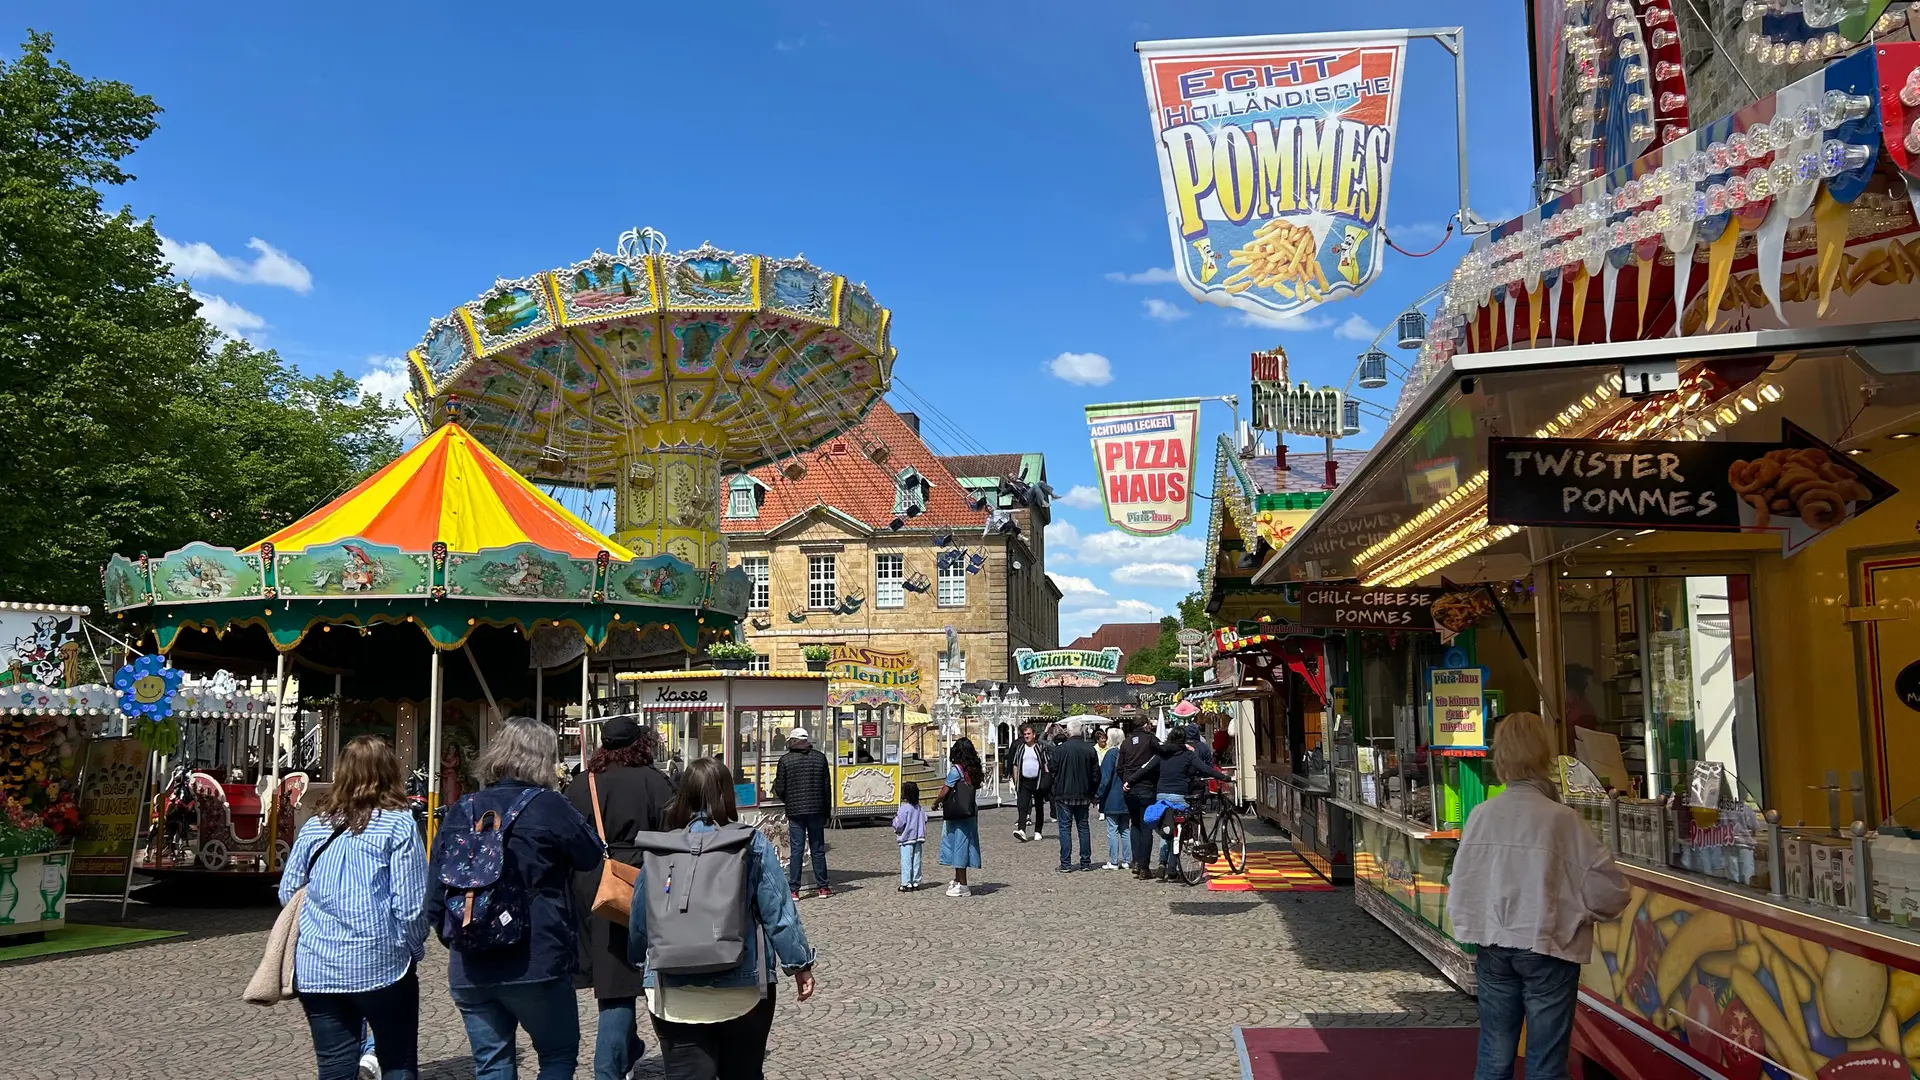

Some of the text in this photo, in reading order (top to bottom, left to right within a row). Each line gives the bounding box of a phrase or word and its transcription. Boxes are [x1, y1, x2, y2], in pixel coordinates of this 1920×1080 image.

[1179, 55, 1339, 99] ECHT
[1165, 76, 1391, 126] HOLLÄNDISCHE
[1161, 115, 1391, 241] POMMES
[1251, 351, 1280, 381] Pizza
[1091, 423, 1133, 437] ACHTUNG
[1134, 416, 1172, 431] LECKER!
[1104, 438, 1187, 471] PIZZA
[1109, 472, 1185, 504] HAUS
[1562, 486, 1718, 517] POMMES
[1335, 609, 1412, 625] POMMES
[1220, 631, 1238, 645] CO
[655, 685, 708, 702] Kasse
[102, 783, 127, 796] DAS
[1689, 818, 1735, 851] Pommes
